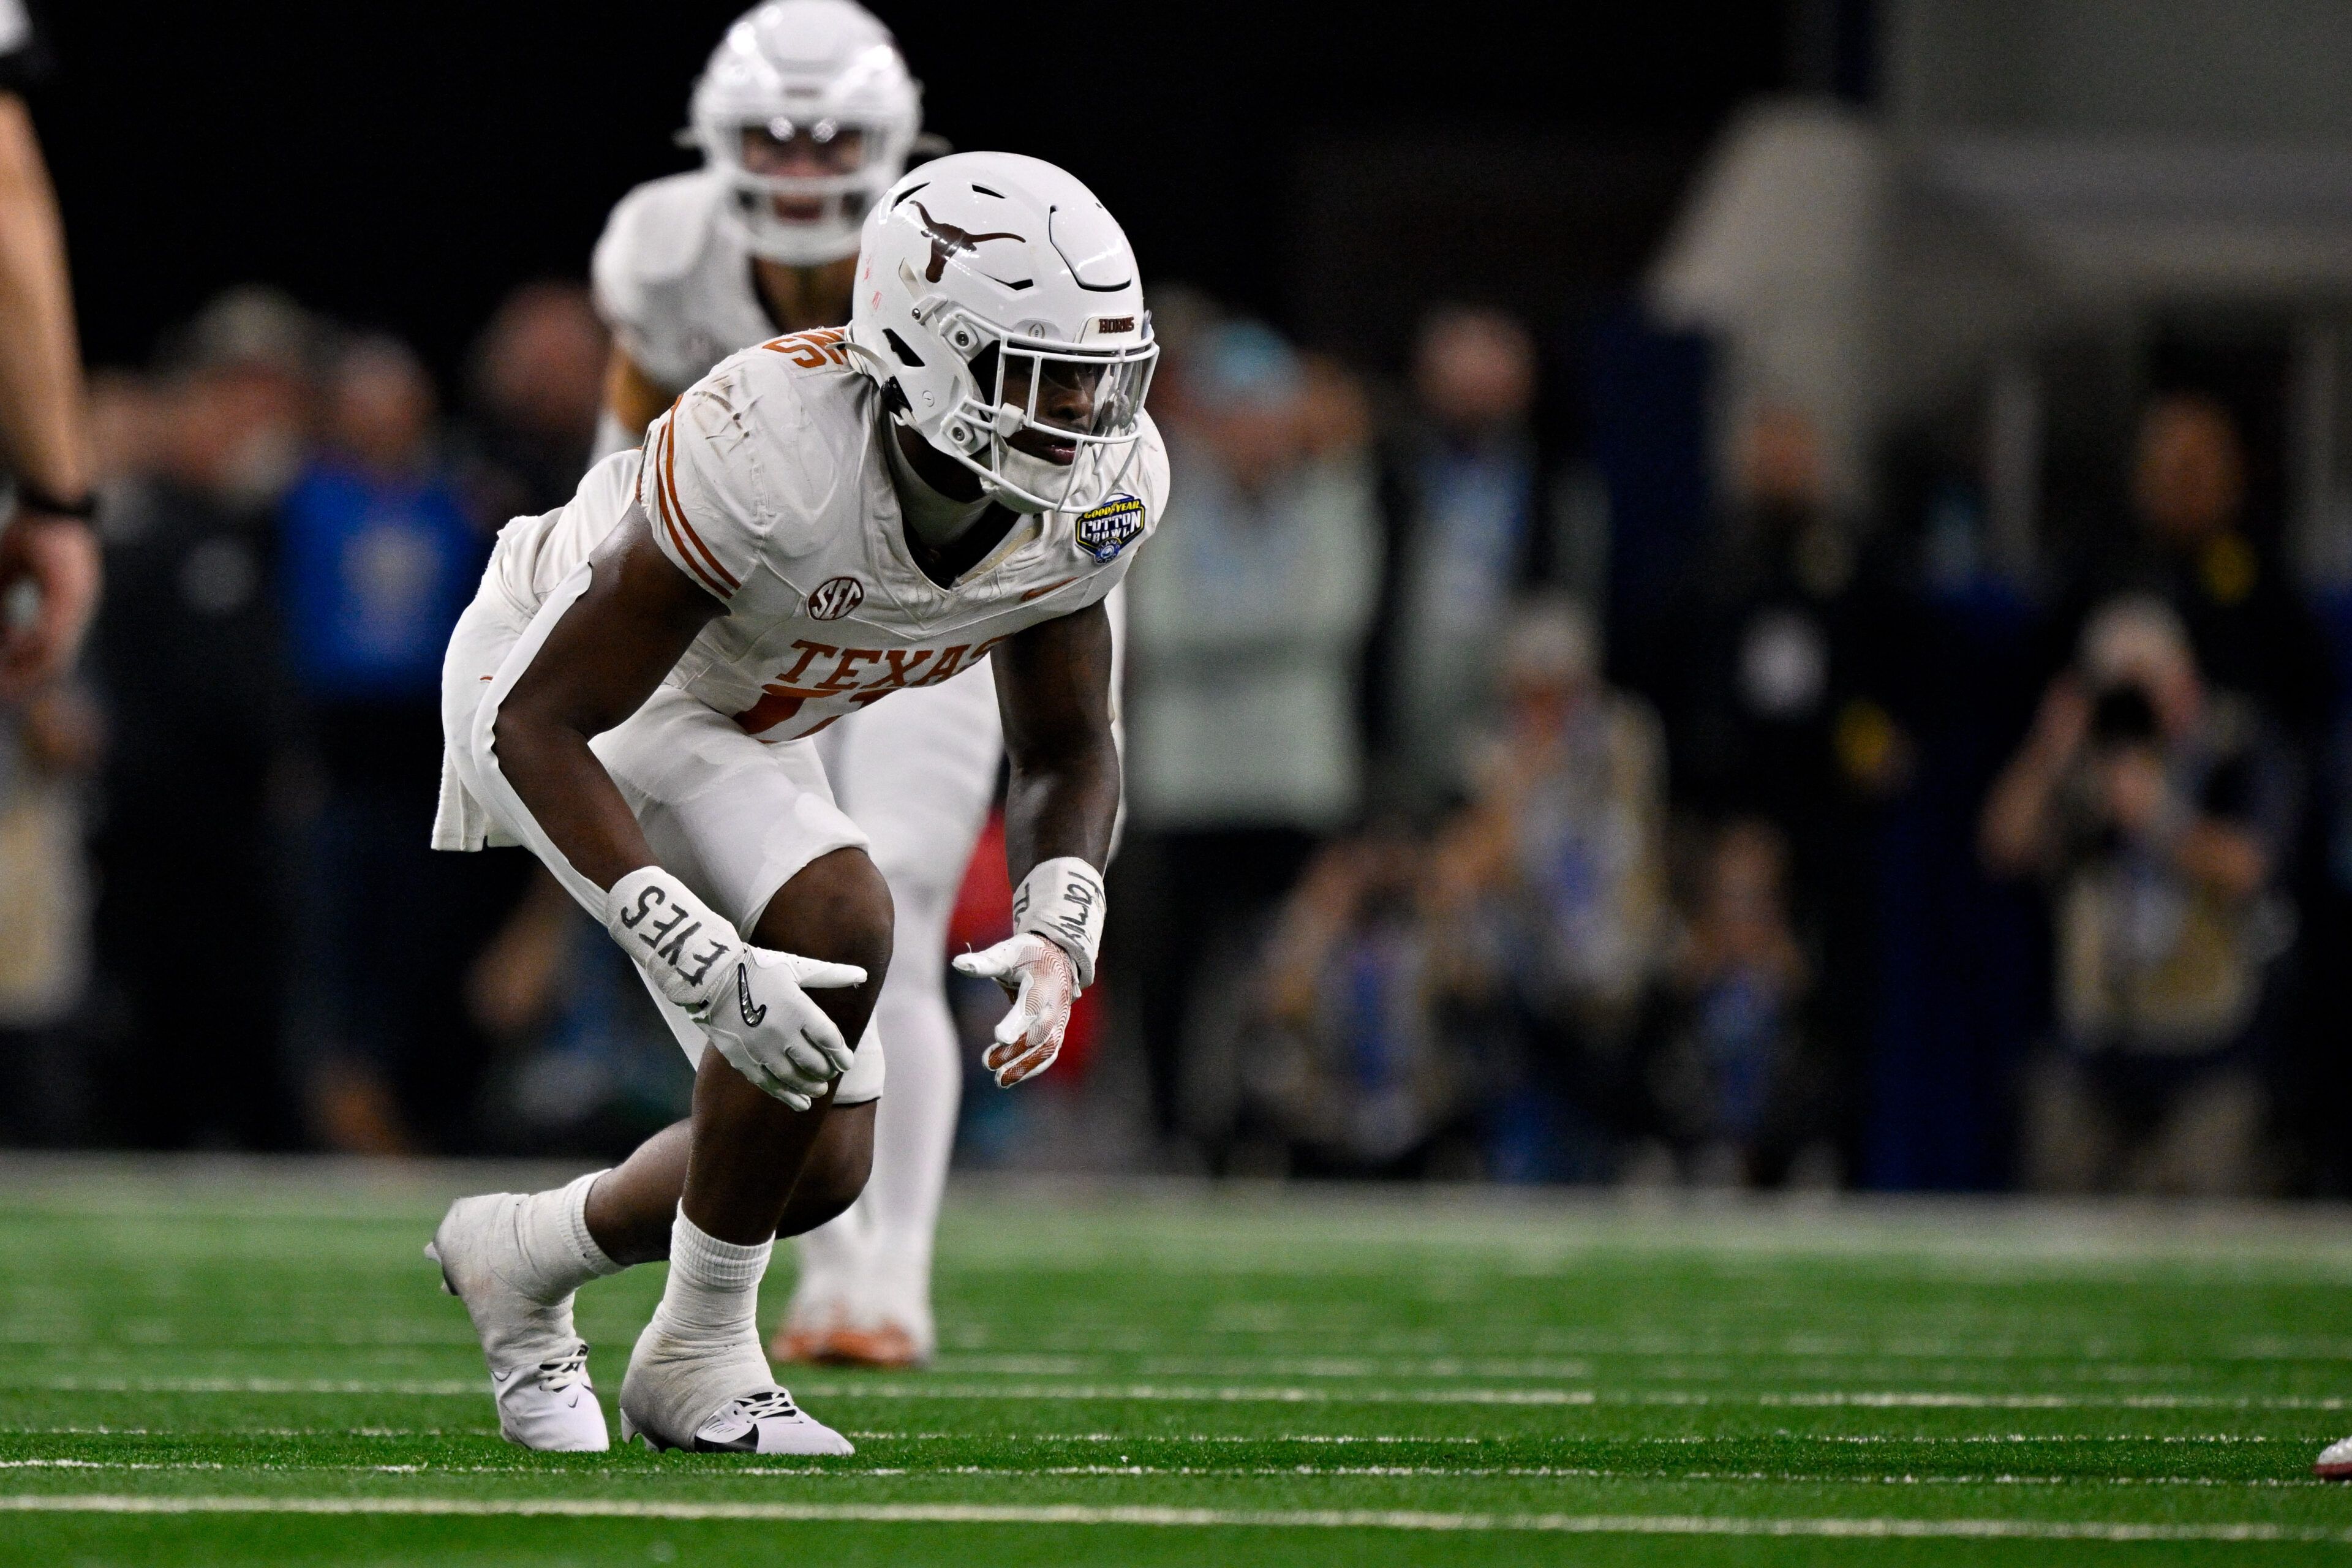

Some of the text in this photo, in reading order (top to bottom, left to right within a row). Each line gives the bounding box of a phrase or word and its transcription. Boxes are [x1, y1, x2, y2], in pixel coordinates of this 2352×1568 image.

[1098, 316, 1134, 334] HORNS
[1081, 510, 1141, 538] COTTON
[1091, 527, 1130, 544] BOWL
[811, 579, 862, 619] SEC
[620, 886, 731, 987] EYES
